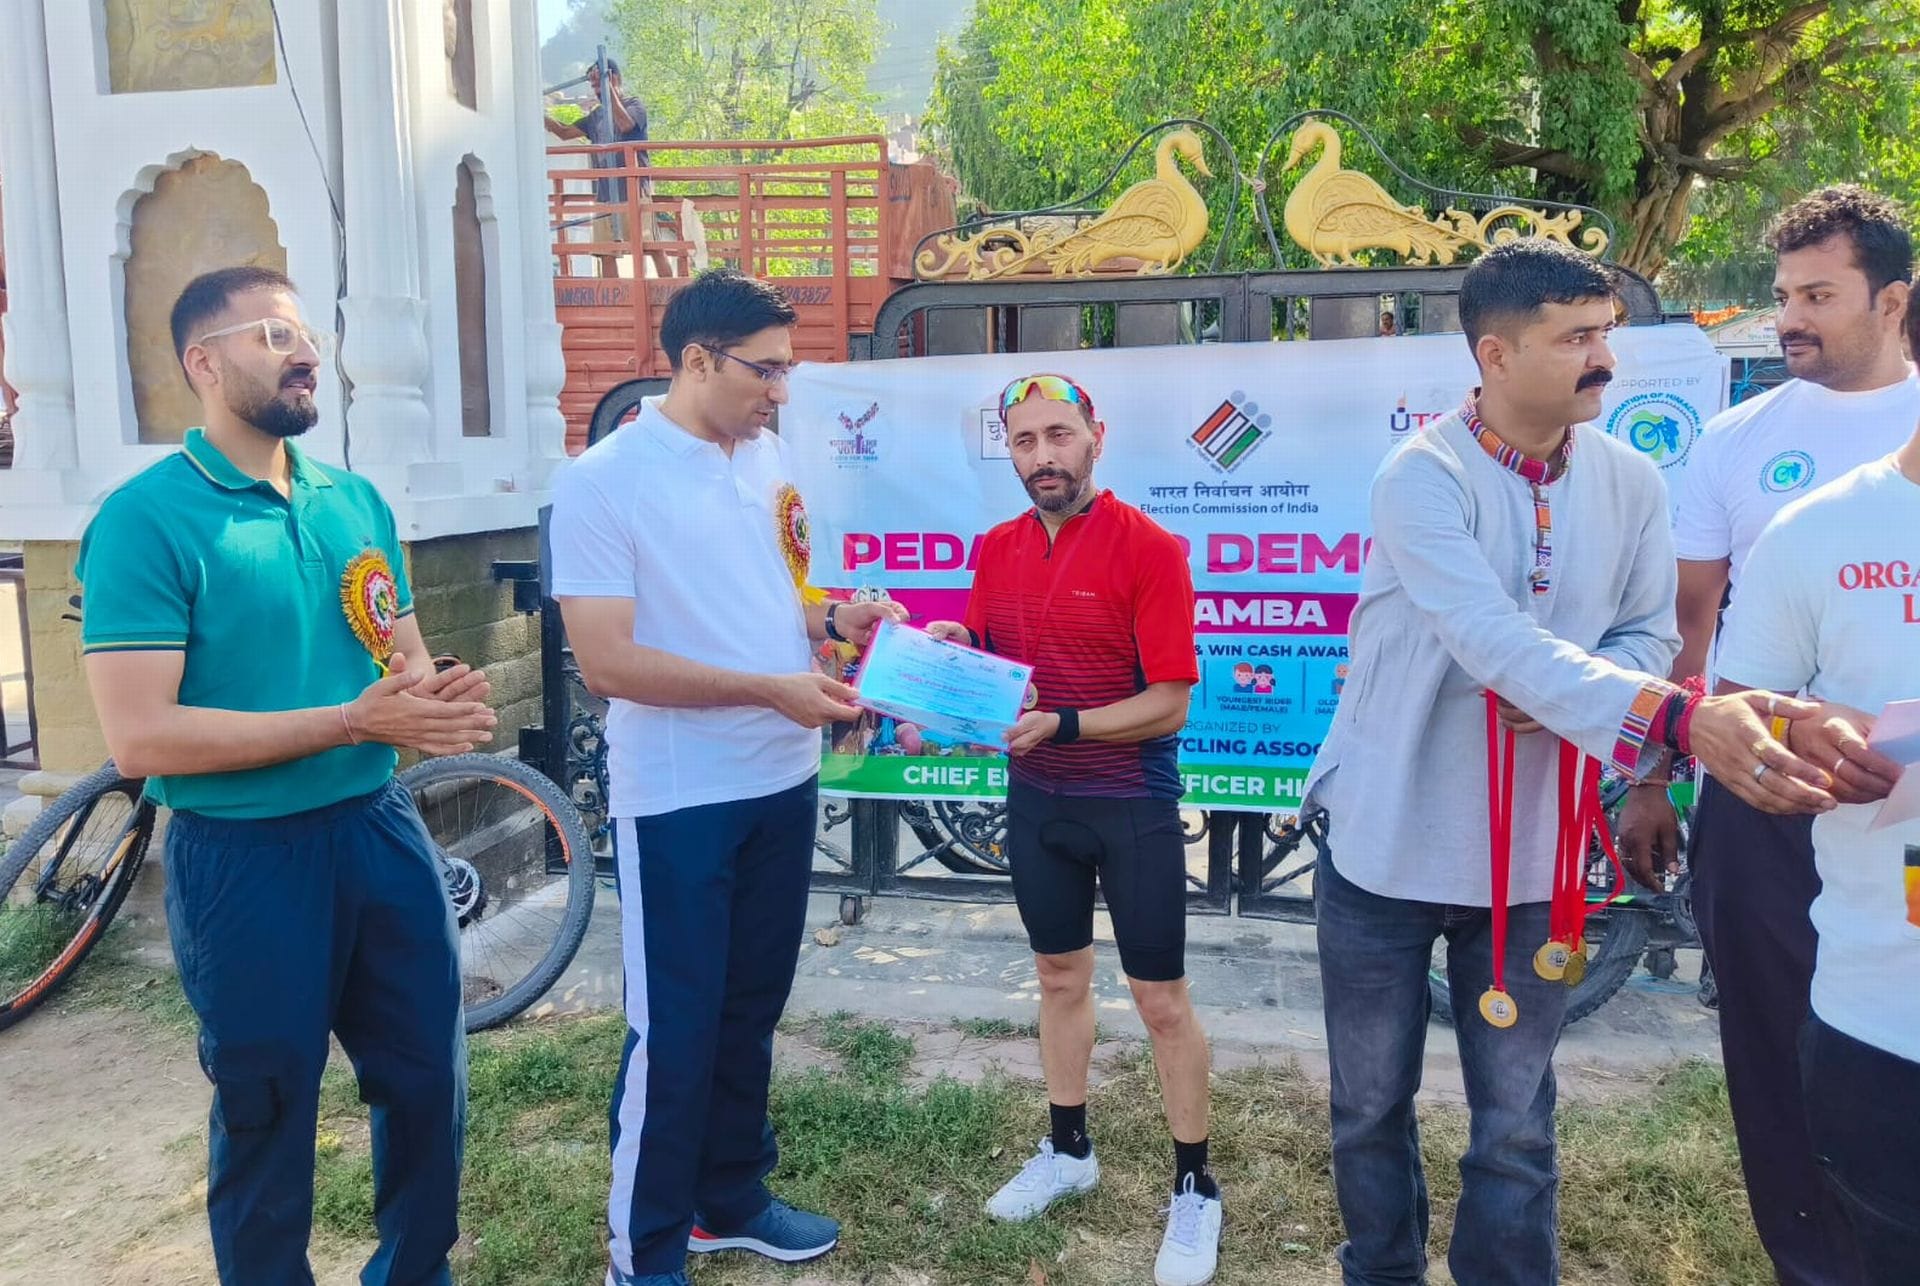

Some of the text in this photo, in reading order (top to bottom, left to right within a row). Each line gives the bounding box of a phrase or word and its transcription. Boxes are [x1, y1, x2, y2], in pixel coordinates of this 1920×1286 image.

[1149, 480, 1310, 499] भारत निर्वाचन आयोग
[1140, 502, 1319, 514] Election Commission of India
[1207, 532, 1371, 574] DEM
[1208, 644, 1242, 656] WIN
[1247, 645, 1291, 657] CASH
[1297, 645, 1349, 657] AWAR
[1262, 723, 1280, 734] BY
[903, 765, 979, 785] CHIEF
